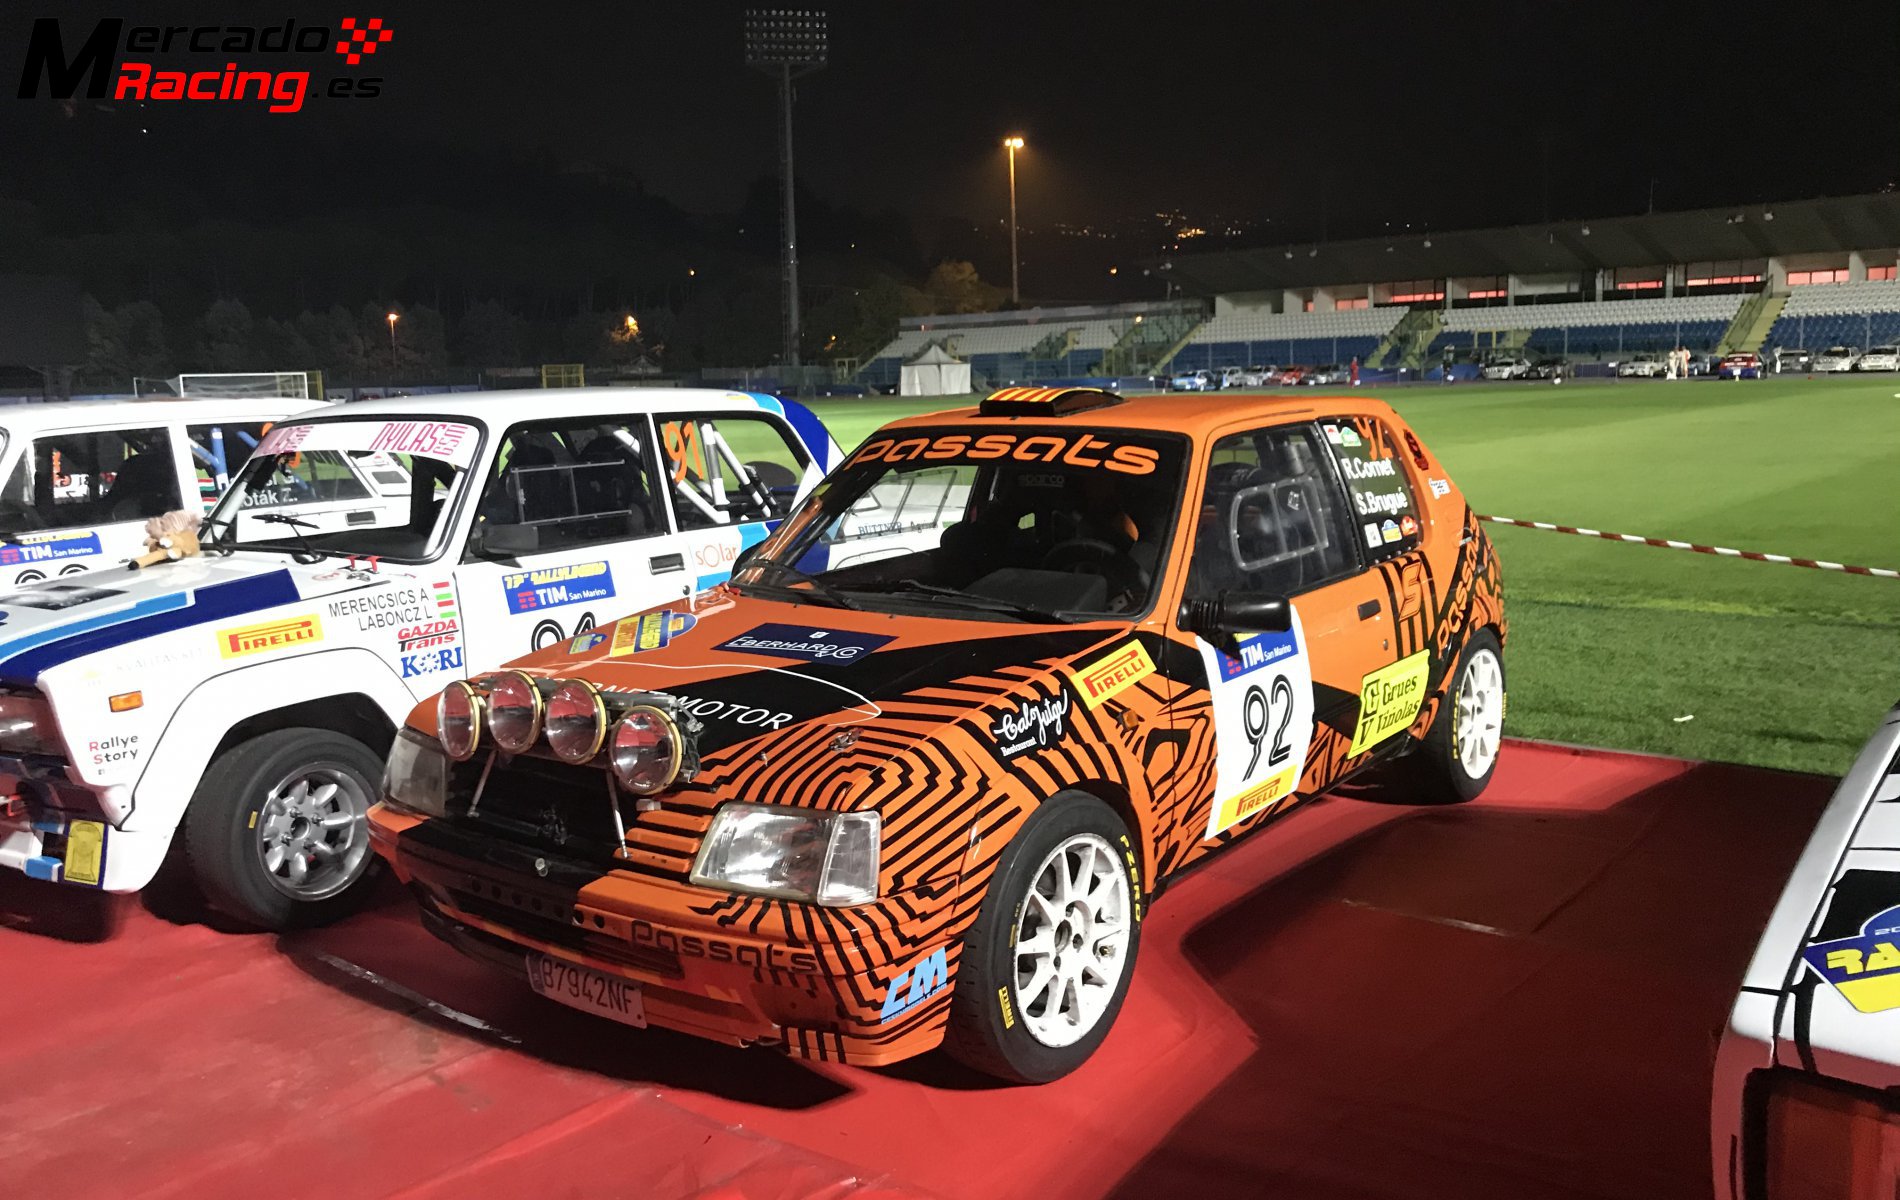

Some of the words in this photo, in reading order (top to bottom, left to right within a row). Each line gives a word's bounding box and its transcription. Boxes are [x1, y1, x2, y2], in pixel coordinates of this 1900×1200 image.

[664, 421, 704, 483] 91
[843, 434, 1159, 475] passats
[20, 545, 53, 561] TIM
[69, 547, 93, 556] Marino
[329, 590, 416, 618] MERENCSICS
[420, 588, 429, 601] A
[535, 586, 569, 606] TIM
[569, 592, 583, 601] San
[583, 589, 606, 599] Marino
[358, 607, 422, 631] LABONCZ
[424, 605, 433, 619] L
[398, 619, 457, 640] GAZDA
[228, 621, 314, 653] PIRELLI
[398, 633, 456, 652] Trans
[1239, 643, 1265, 669] TIM
[1264, 650, 1274, 661] San
[1273, 644, 1292, 657] Marino
[1083, 649, 1145, 698] PIRELLI
[1382, 675, 1418, 706] Grues
[677, 696, 794, 730] MOTOR
[1242, 674, 1293, 782] 92
[89, 735, 138, 752] Rallye
[93, 749, 138, 764] Story
[1236, 777, 1281, 816] PIRELLI
[542, 959, 635, 1014] B7942NF
